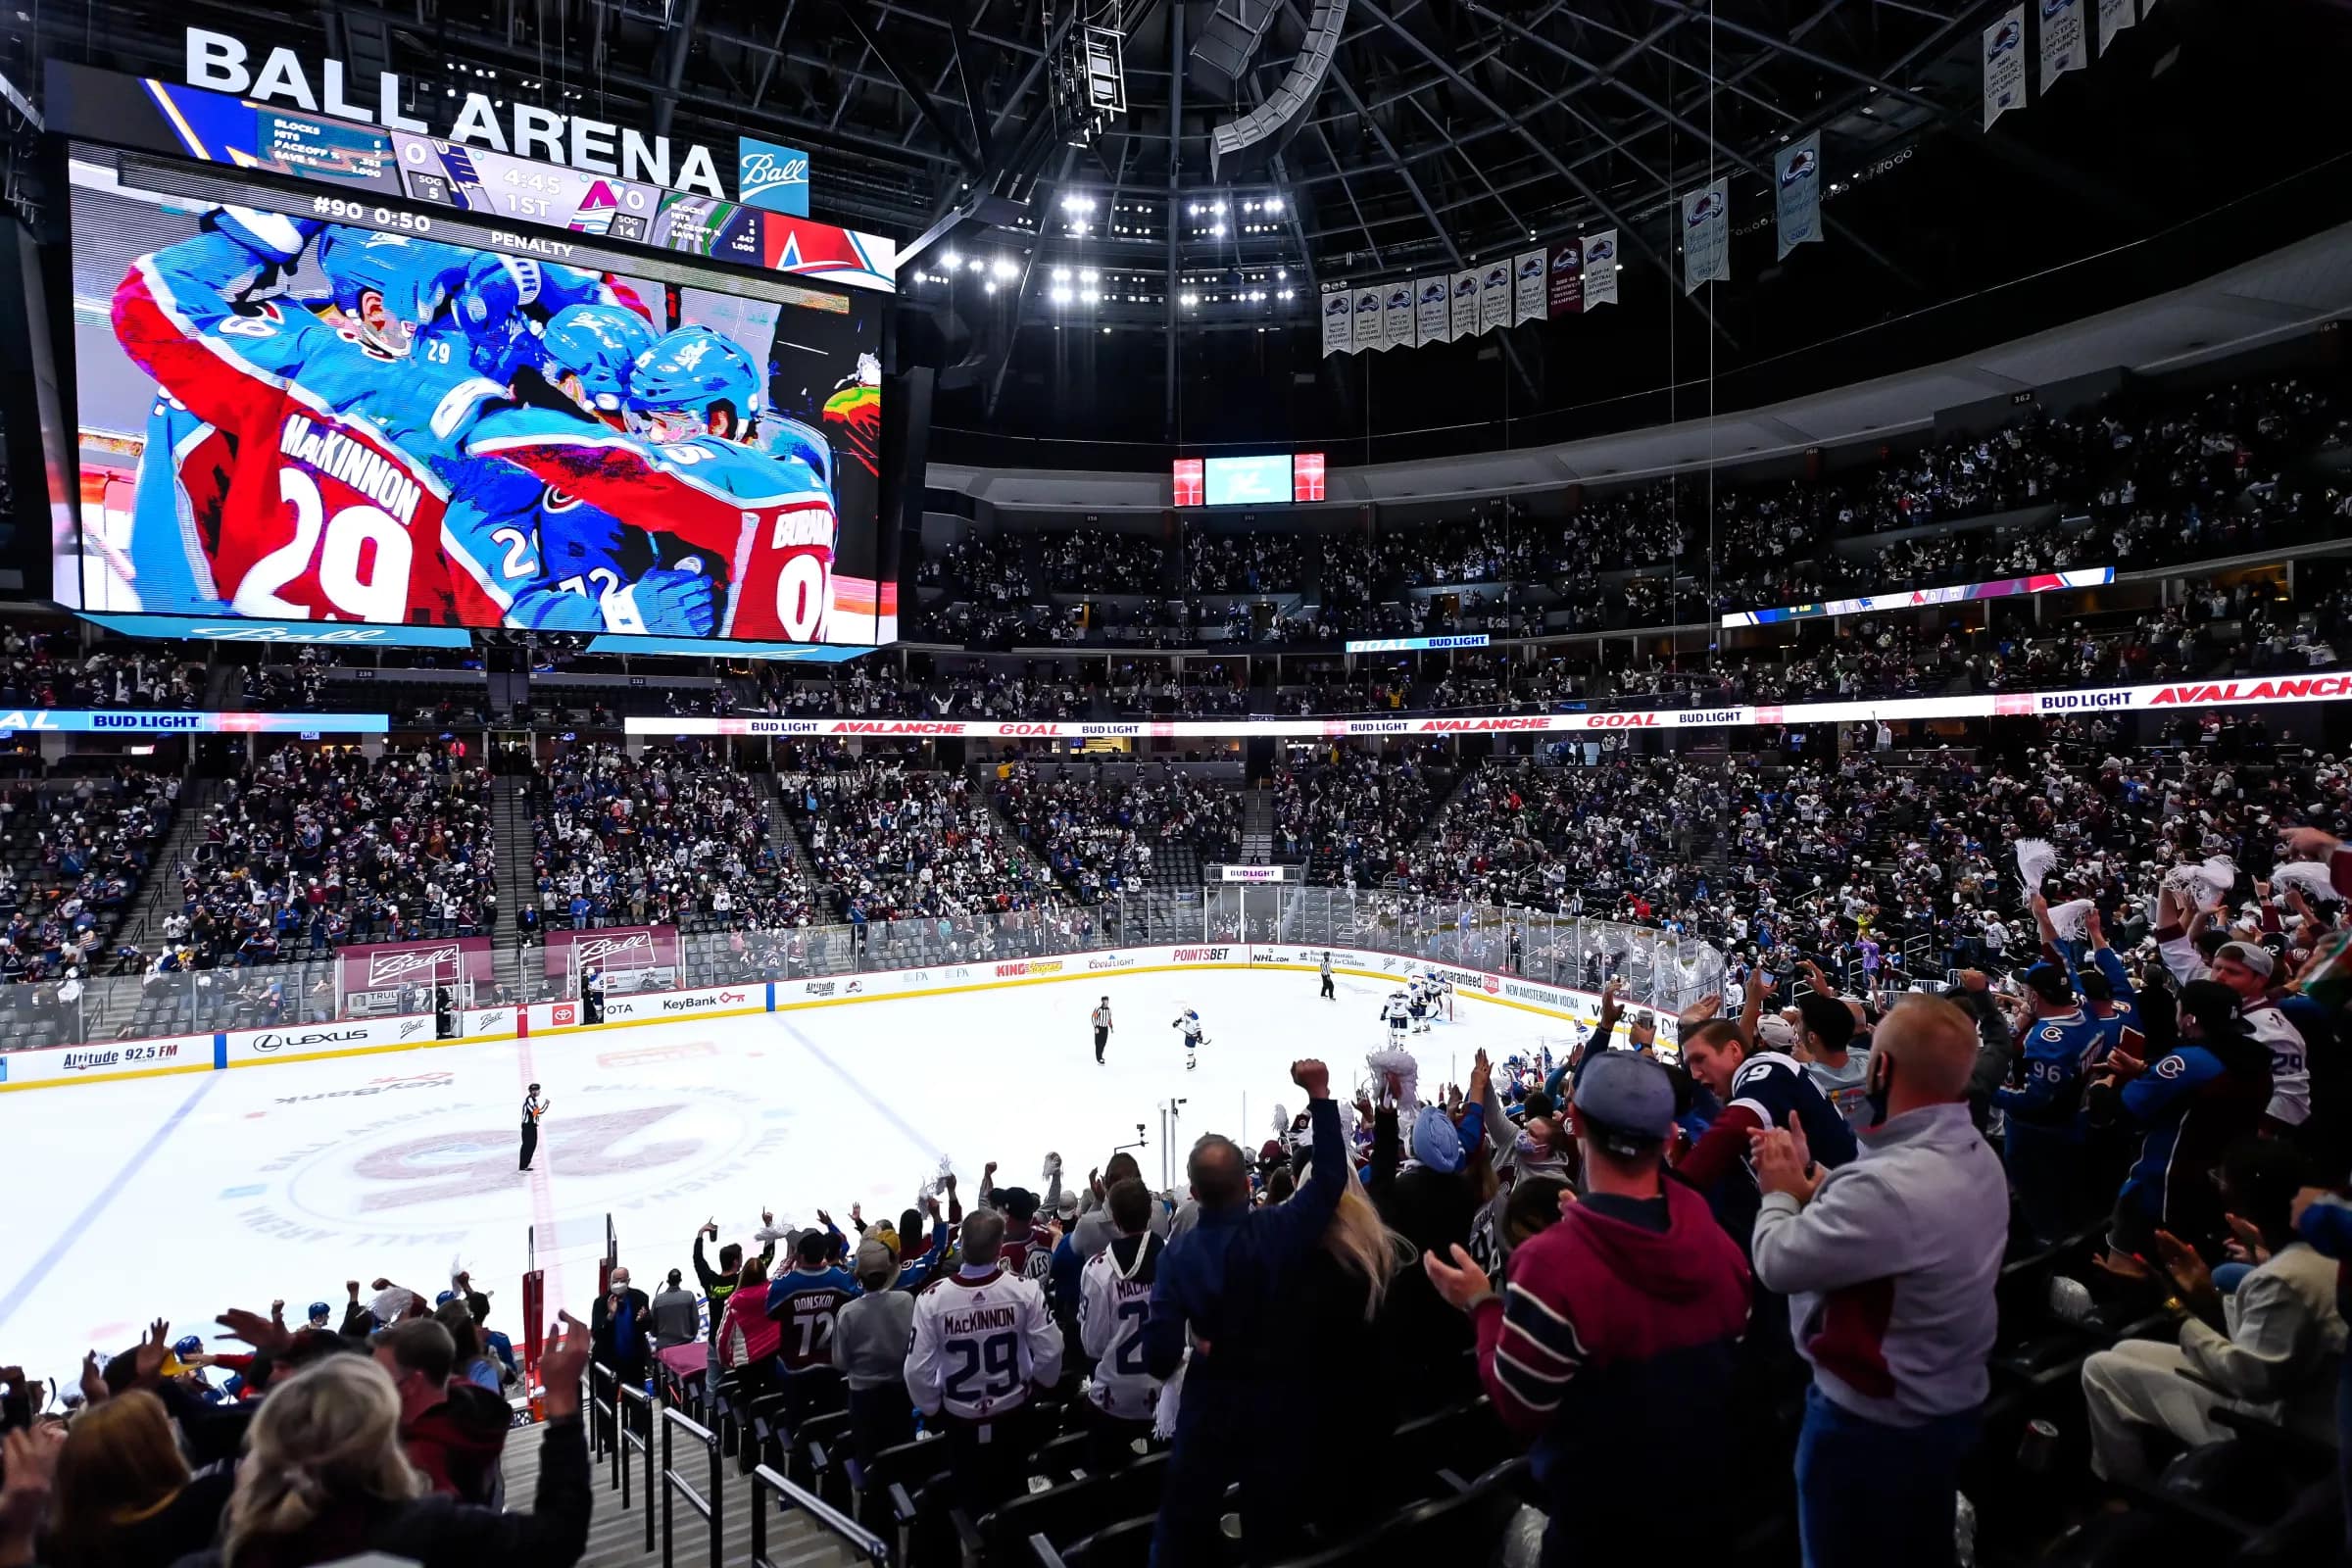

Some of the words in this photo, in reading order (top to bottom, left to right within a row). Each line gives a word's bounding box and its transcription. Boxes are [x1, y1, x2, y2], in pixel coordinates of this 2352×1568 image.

[186, 26, 427, 134] BALL
[450, 93, 726, 200] ARENA
[273, 119, 320, 135] BLOCKS
[273, 129, 301, 142] HITS
[273, 139, 328, 156] FACEOFF
[405, 142, 427, 165] 0
[273, 150, 308, 166] SAVE
[352, 166, 382, 178] 1.000
[741, 152, 808, 190] Ball
[418, 174, 442, 186] SOG
[503, 168, 561, 195] 4:45
[428, 187, 439, 199] 5
[625, 190, 645, 211] 0
[313, 196, 364, 220] #90
[373, 207, 431, 231] 0:50
[507, 194, 552, 218] 1ST
[670, 203, 707, 217] BLOCKS
[617, 215, 638, 226] SOG
[670, 212, 691, 222] HITS
[617, 225, 636, 238] 14
[670, 220, 712, 235] FACEOFF
[670, 229, 696, 241] SAVE
[491, 231, 573, 258] PENALTY
[732, 242, 755, 253] 1.000
[427, 340, 451, 364] 29
[231, 468, 415, 623] 29
[1348, 639, 1413, 652] GOAL
[1428, 637, 1451, 647] BUD
[1453, 635, 1487, 647] LIGHT
[2041, 696, 2079, 710] BUD
[2082, 691, 2133, 708] LIGHT
[93, 714, 144, 729] BUD
[146, 714, 200, 729] LIGHT
[751, 721, 777, 732] BUD
[779, 722, 818, 732] LIGHT
[830, 721, 968, 735] AVALANCHE
[998, 723, 1063, 736] GOAL
[1082, 724, 1102, 735] BUD
[1104, 725, 1140, 735] LIGHT
[1350, 721, 1375, 733] BUD
[1377, 720, 1409, 732] LIGHT
[1418, 716, 1553, 732] AVALANCHE
[1586, 712, 1661, 728] GOAL
[1679, 712, 1702, 724] BUD
[1705, 710, 1742, 723] LIGHT
[579, 934, 648, 958] Ball
[374, 948, 456, 977] Ball
[1111, 957, 1135, 967] LIGHT
[1173, 948, 1230, 962] POINTSBET
[1252, 954, 1290, 963] NHL.COM
[996, 962, 1026, 977] KING
[806, 981, 835, 994] Altitude
[1505, 983, 1518, 996] NEW
[1519, 987, 1558, 1006] AMSTERDAM
[1558, 996, 1579, 1009] VODKA
[662, 995, 717, 1011] KeyBank
[400, 1018, 425, 1040] Ball
[480, 1010, 505, 1031] Ball
[285, 1028, 368, 1047] LEXUS
[63, 1051, 119, 1070] Altitude
[124, 1046, 155, 1061] 92.5
[159, 1044, 178, 1056] FM
[2034, 1059, 2062, 1083] 96
[794, 1294, 835, 1311] DONSKOI
[944, 1306, 1016, 1336] MacKINNON
[793, 1310, 834, 1357] 72
[945, 1331, 1020, 1403] 29
